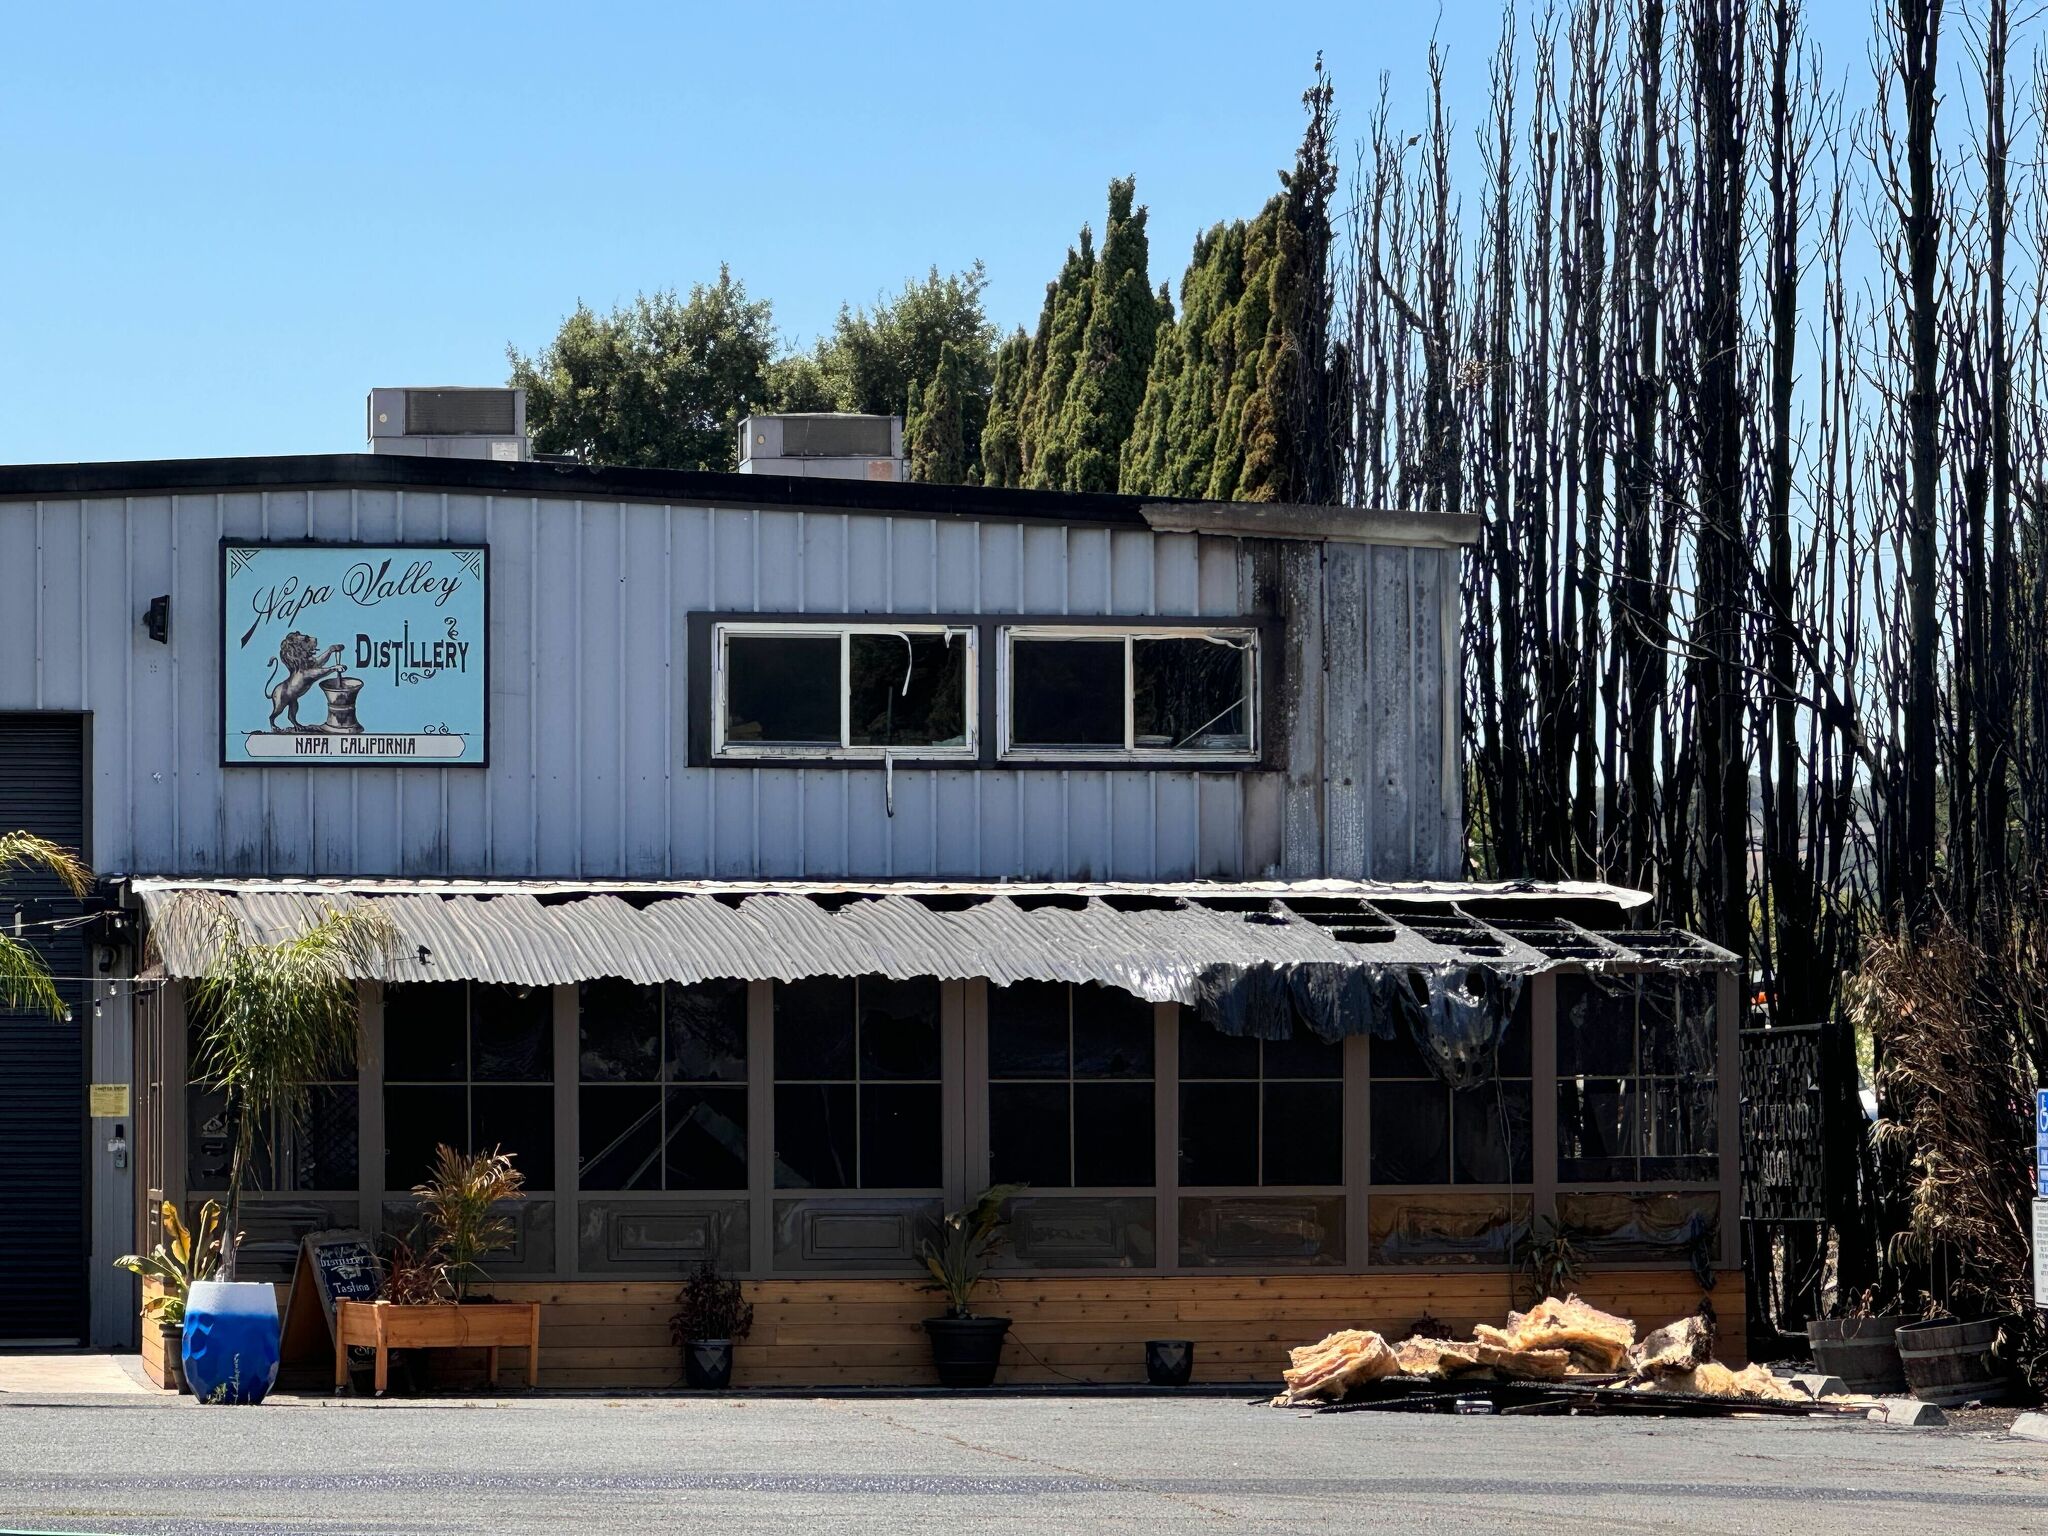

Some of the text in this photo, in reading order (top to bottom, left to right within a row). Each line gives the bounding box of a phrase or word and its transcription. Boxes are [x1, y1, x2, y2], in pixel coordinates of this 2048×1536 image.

[241, 558, 462, 649] Napa Valley
[295, 737, 416, 755] NAPA, CALIFORNIA
